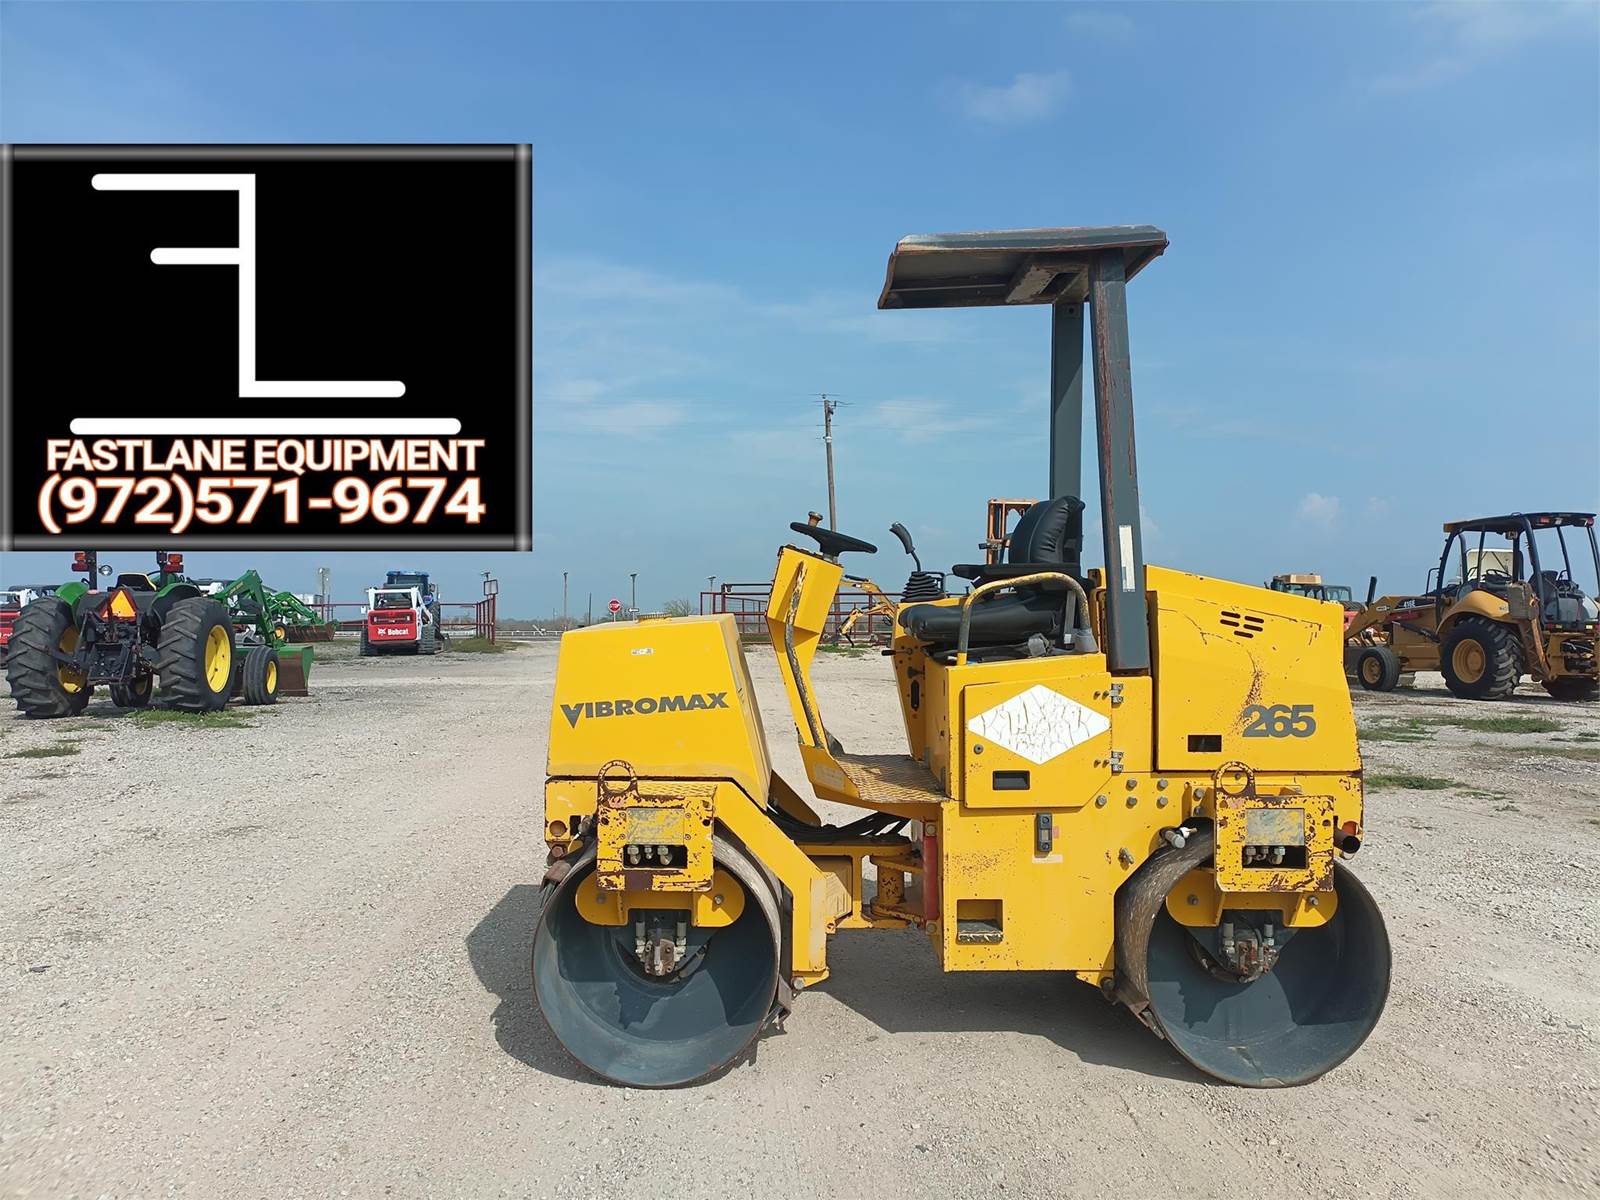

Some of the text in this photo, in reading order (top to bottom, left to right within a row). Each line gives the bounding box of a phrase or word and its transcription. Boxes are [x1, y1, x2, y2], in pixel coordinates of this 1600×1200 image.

[387, 628, 409, 636] Bobcat
[561, 692, 729, 728] VIBROMAX
[1243, 703, 1316, 737] 265
